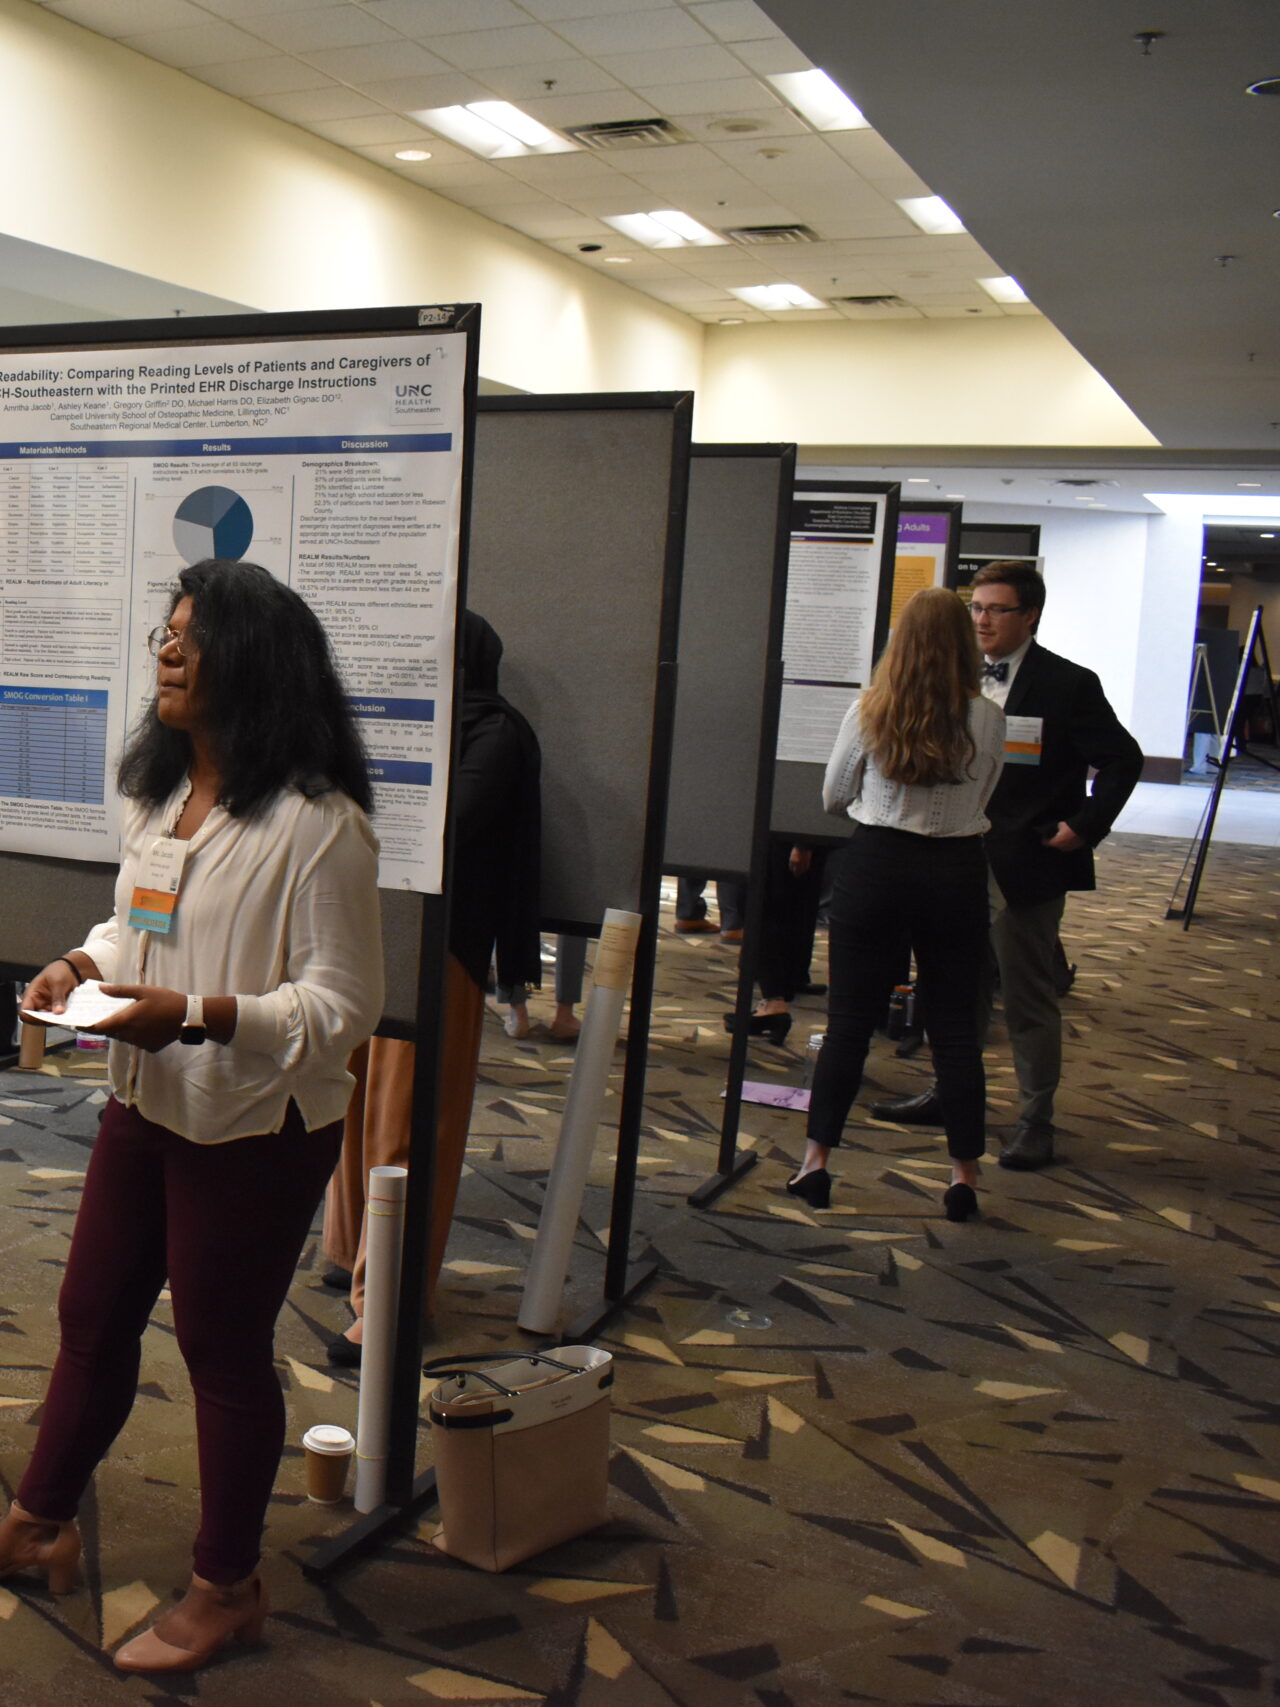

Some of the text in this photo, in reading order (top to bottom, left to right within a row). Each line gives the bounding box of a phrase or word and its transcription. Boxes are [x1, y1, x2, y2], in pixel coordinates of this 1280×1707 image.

[68, 367, 134, 382] Comparing
[139, 366, 190, 379] Reading
[195, 363, 233, 375] Levels
[238, 362, 251, 373] of
[254, 360, 306, 372] Patients
[311, 358, 335, 370] and
[339, 355, 412, 371] Caregivers
[417, 354, 431, 365] of
[98, 384, 122, 395] with
[127, 383, 146, 394] the
[151, 382, 195, 393] Printed
[199, 381, 225, 392] EHR
[230, 378, 294, 393] Discharge
[299, 375, 377, 388] Instructions
[395, 384, 432, 397] UNC
[58, 402, 82, 411] Ashley
[114, 401, 143, 410] Gregory
[188, 398, 216, 406] Michael
[217, 397, 239, 405] Harris
[257, 396, 291, 404] Elizabeth
[293, 395, 320, 404] Gignac
[50, 412, 83, 422] Campbell
[85, 411, 120, 421] University
[158, 409, 201, 420] Osteopathic
[203, 408, 235, 418] Medicine,
[119, 421, 151, 431] Regional
[210, 418, 250, 428] Lumberton,
[20, 446, 87, 454] Materials/Methods
[904, 523, 930, 532] Adults
[25, 692, 63, 701] Conversion
[65, 694, 85, 702] Table
[350, 704, 385, 712] nclusion
